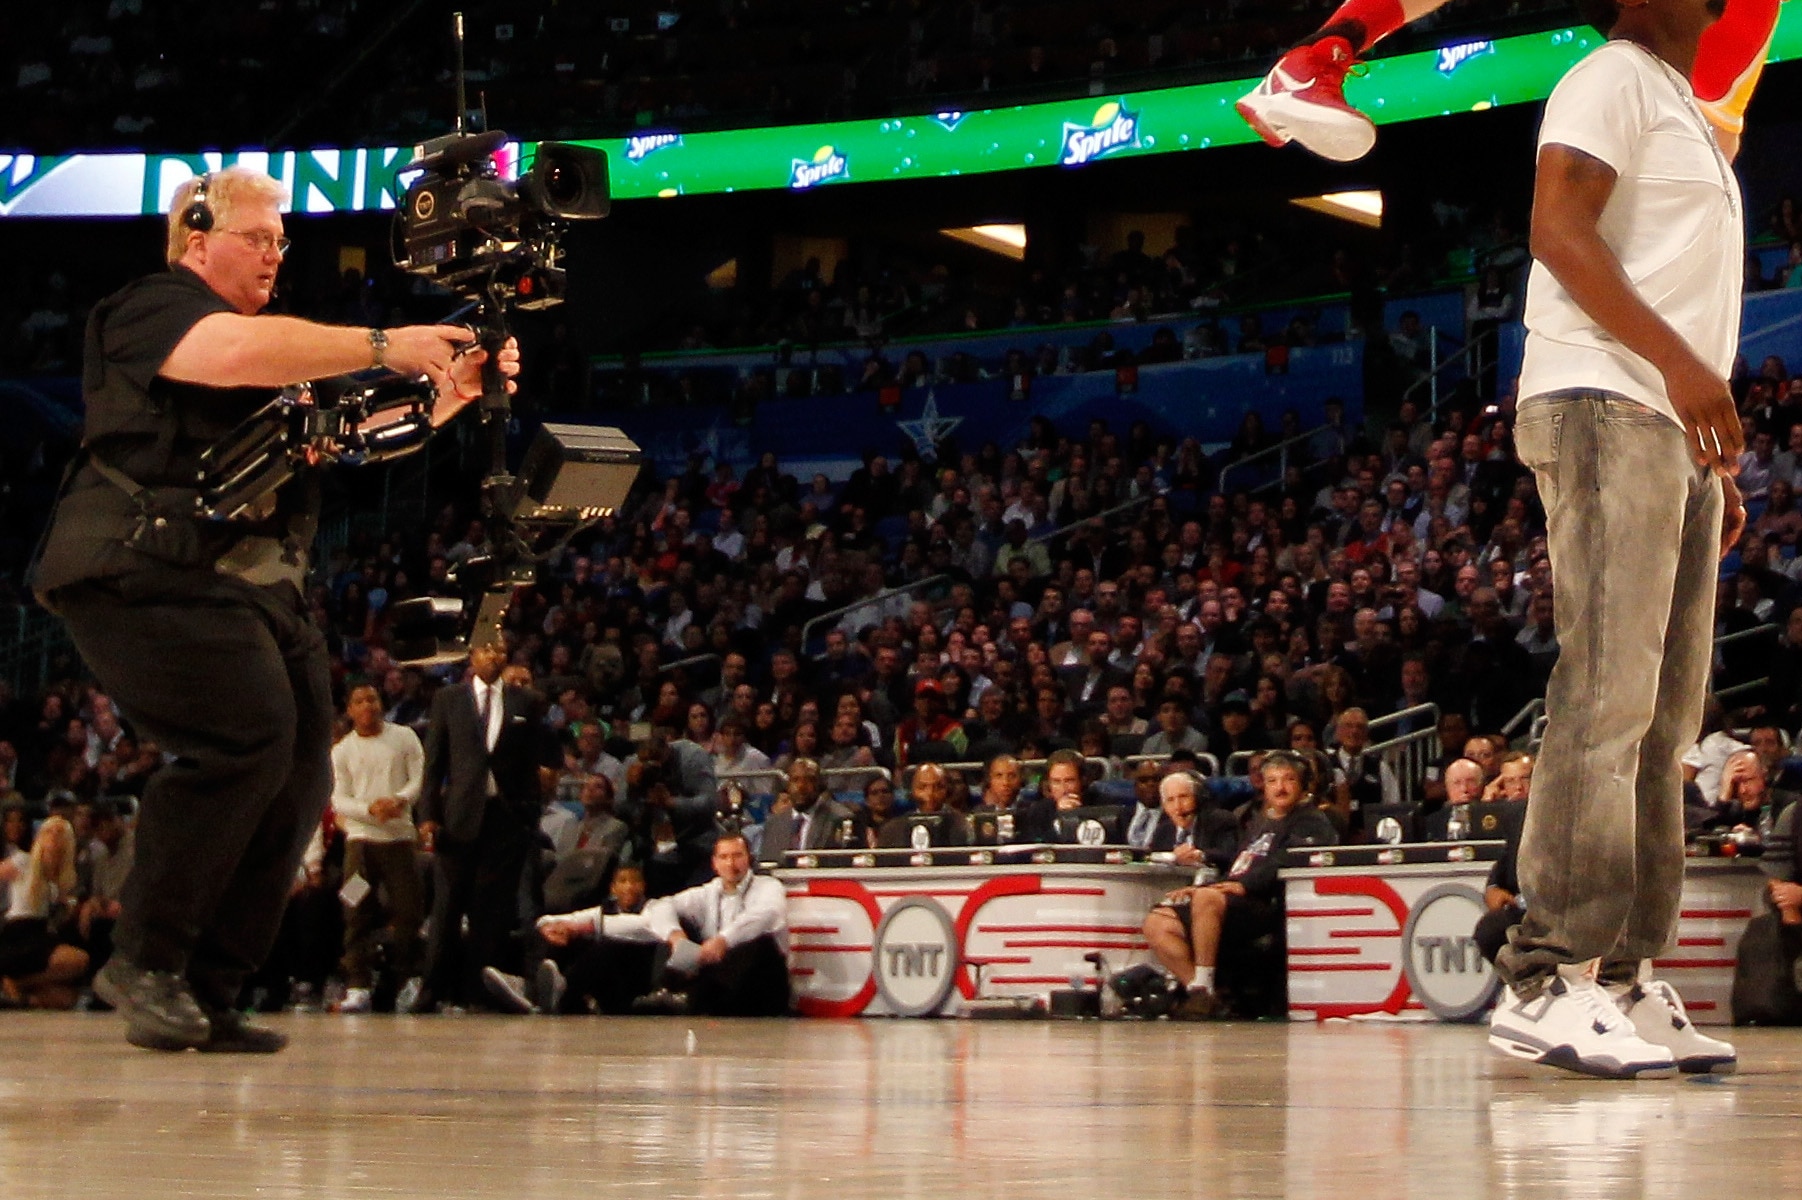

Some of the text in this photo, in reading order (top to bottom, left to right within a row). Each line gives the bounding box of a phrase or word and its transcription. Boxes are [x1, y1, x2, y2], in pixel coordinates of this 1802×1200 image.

[1063, 113, 1134, 165] Sprite
[792, 153, 845, 189] Sprite
[884, 942, 945, 979] TNT
